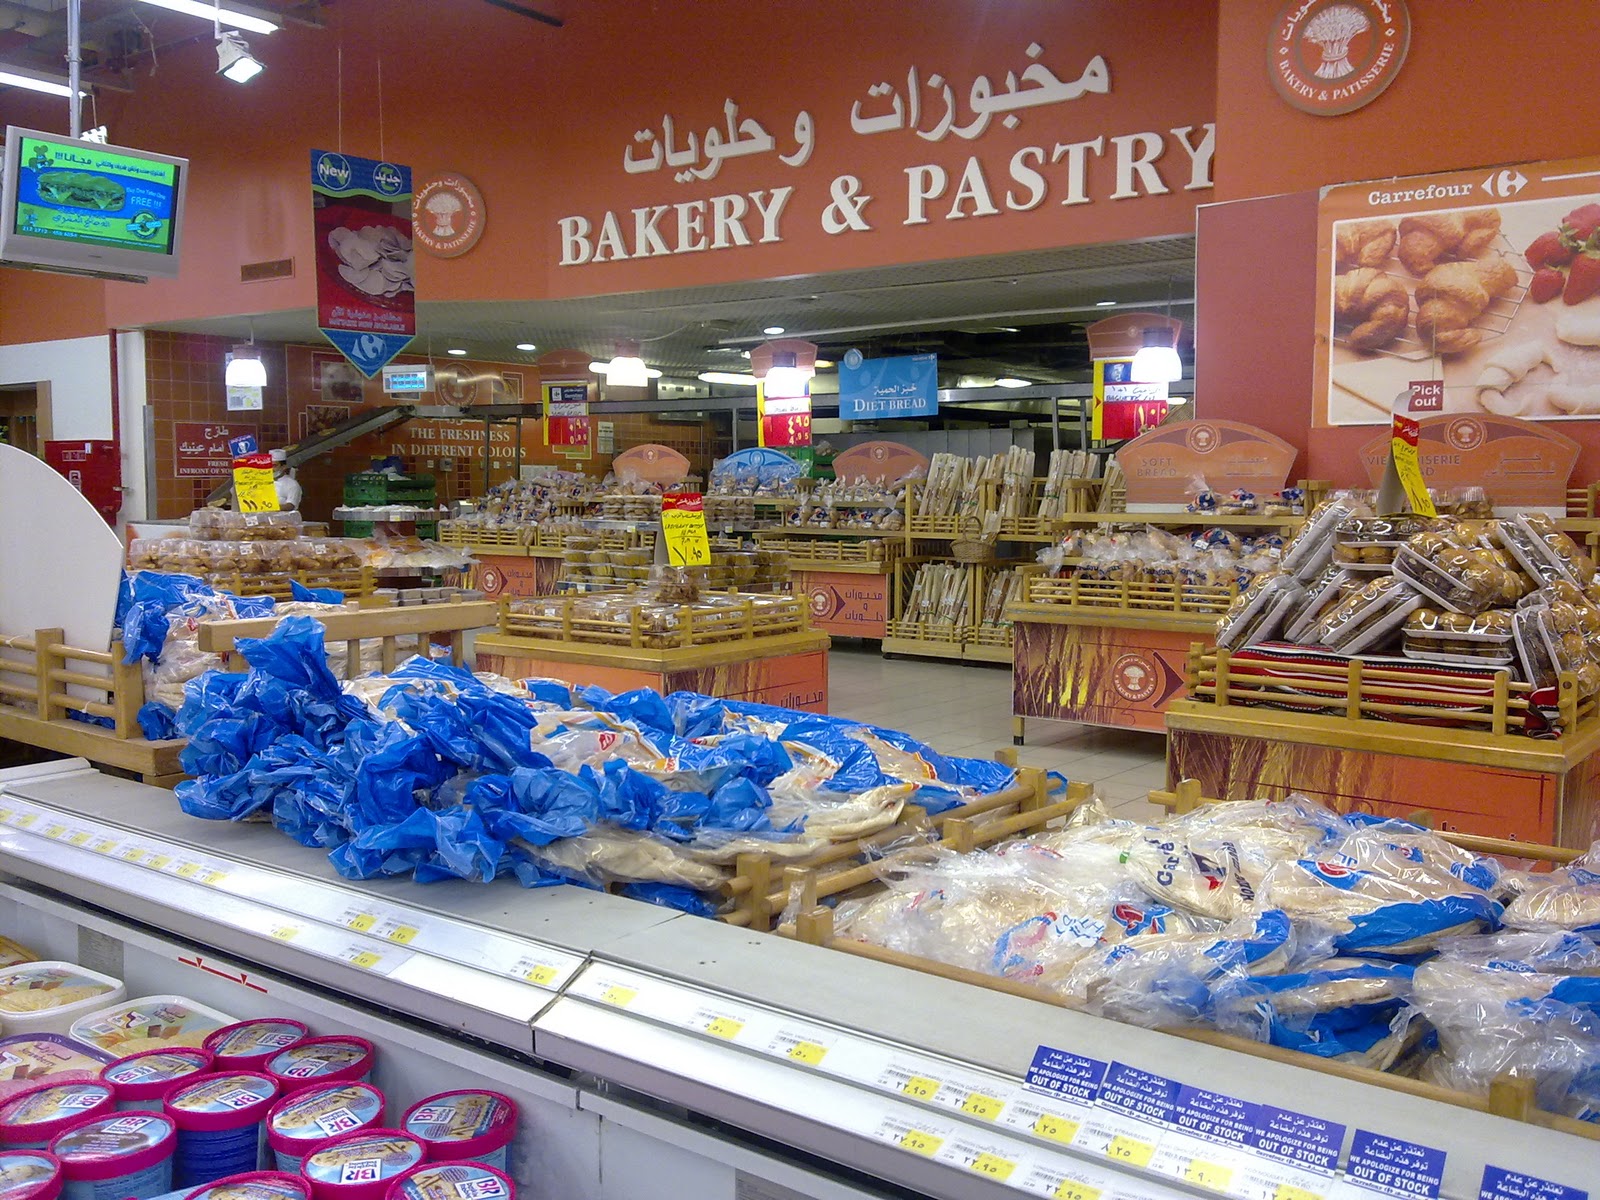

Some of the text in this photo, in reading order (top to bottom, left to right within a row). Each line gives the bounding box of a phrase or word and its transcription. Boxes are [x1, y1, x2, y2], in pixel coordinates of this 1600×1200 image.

[1280, 42, 1394, 100] BAKERY & PATISSERIE
[623, 41, 1112, 183] مخبوزات و حلويات
[320, 164, 348, 178] New
[376, 170, 400, 187] جديد
[558, 122, 1216, 267] BAKERY & PASTRY
[1368, 182, 1473, 206] Carrefour
[131, 196, 152, 207] FREE
[413, 222, 433, 246] BAKERY
[444, 221, 476, 249] PATISSERIE
[901, 383, 916, 394] خبز
[1412, 385, 1441, 395] Pick
[889, 398, 926, 410] BREAD
[1415, 397, 1436, 407] out
[204, 426, 229, 439] طازج
[410, 428, 510, 441] THE FRESHNESS
[180, 441, 224, 456] أمام عينيك
[392, 444, 406, 455] IN
[411, 444, 474, 456] DIFFRENT
[1143, 458, 1172, 467] SOFT
[1368, 455, 1460, 464] VIEISERIE
[1049, 1051, 1064, 1060] عدم
[1063, 1054, 1075, 1064] عن
[1038, 1069, 1068, 1081] APOLOGIZE
[1080, 1080, 1098, 1090] BEING
[1123, 1068, 1138, 1078] عدم
[1137, 1072, 1149, 1082] عن
[1030, 1074, 1090, 1097] OUT OF STOCK
[1112, 1085, 1142, 1100] APOLOGIZE
[1143, 1095, 1155, 1104] FOR
[1155, 1100, 1174, 1110] BEING
[1197, 1091, 1212, 1100] عدم
[1212, 1095, 1224, 1104] عن
[1103, 1090, 1165, 1118] OUT OF STOCK
[414, 1108, 438, 1121] BR
[1186, 1109, 1219, 1123] APOLOGIZE
[1220, 1118, 1232, 1126] FOR
[1233, 1122, 1253, 1132] BEING
[1277, 1112, 1292, 1122] عدم
[1293, 1116, 1306, 1126] عن
[328, 1117, 357, 1133] BR
[1178, 1115, 1244, 1142] OUT OF STOCK
[1266, 1132, 1302, 1146] APOLOGIZE
[1303, 1142, 1316, 1150] FOR
[1317, 1146, 1338, 1157] BEING
[1372, 1137, 1388, 1148] عدم
[1389, 1141, 1402, 1152] عن
[1258, 1138, 1329, 1166] OUT OF STOCK
[346, 1168, 376, 1180] BR
[1349, 1154, 1439, 1185] WE APOLOGIZE FOR BEING
[1353, 1165, 1430, 1195] OUT OF STOCK
[1505, 1174, 1522, 1184] عدم
[1525, 1178, 1538, 1188] عن
[476, 1179, 500, 1194] BR
[1480, 1190, 1492, 1200] WE
